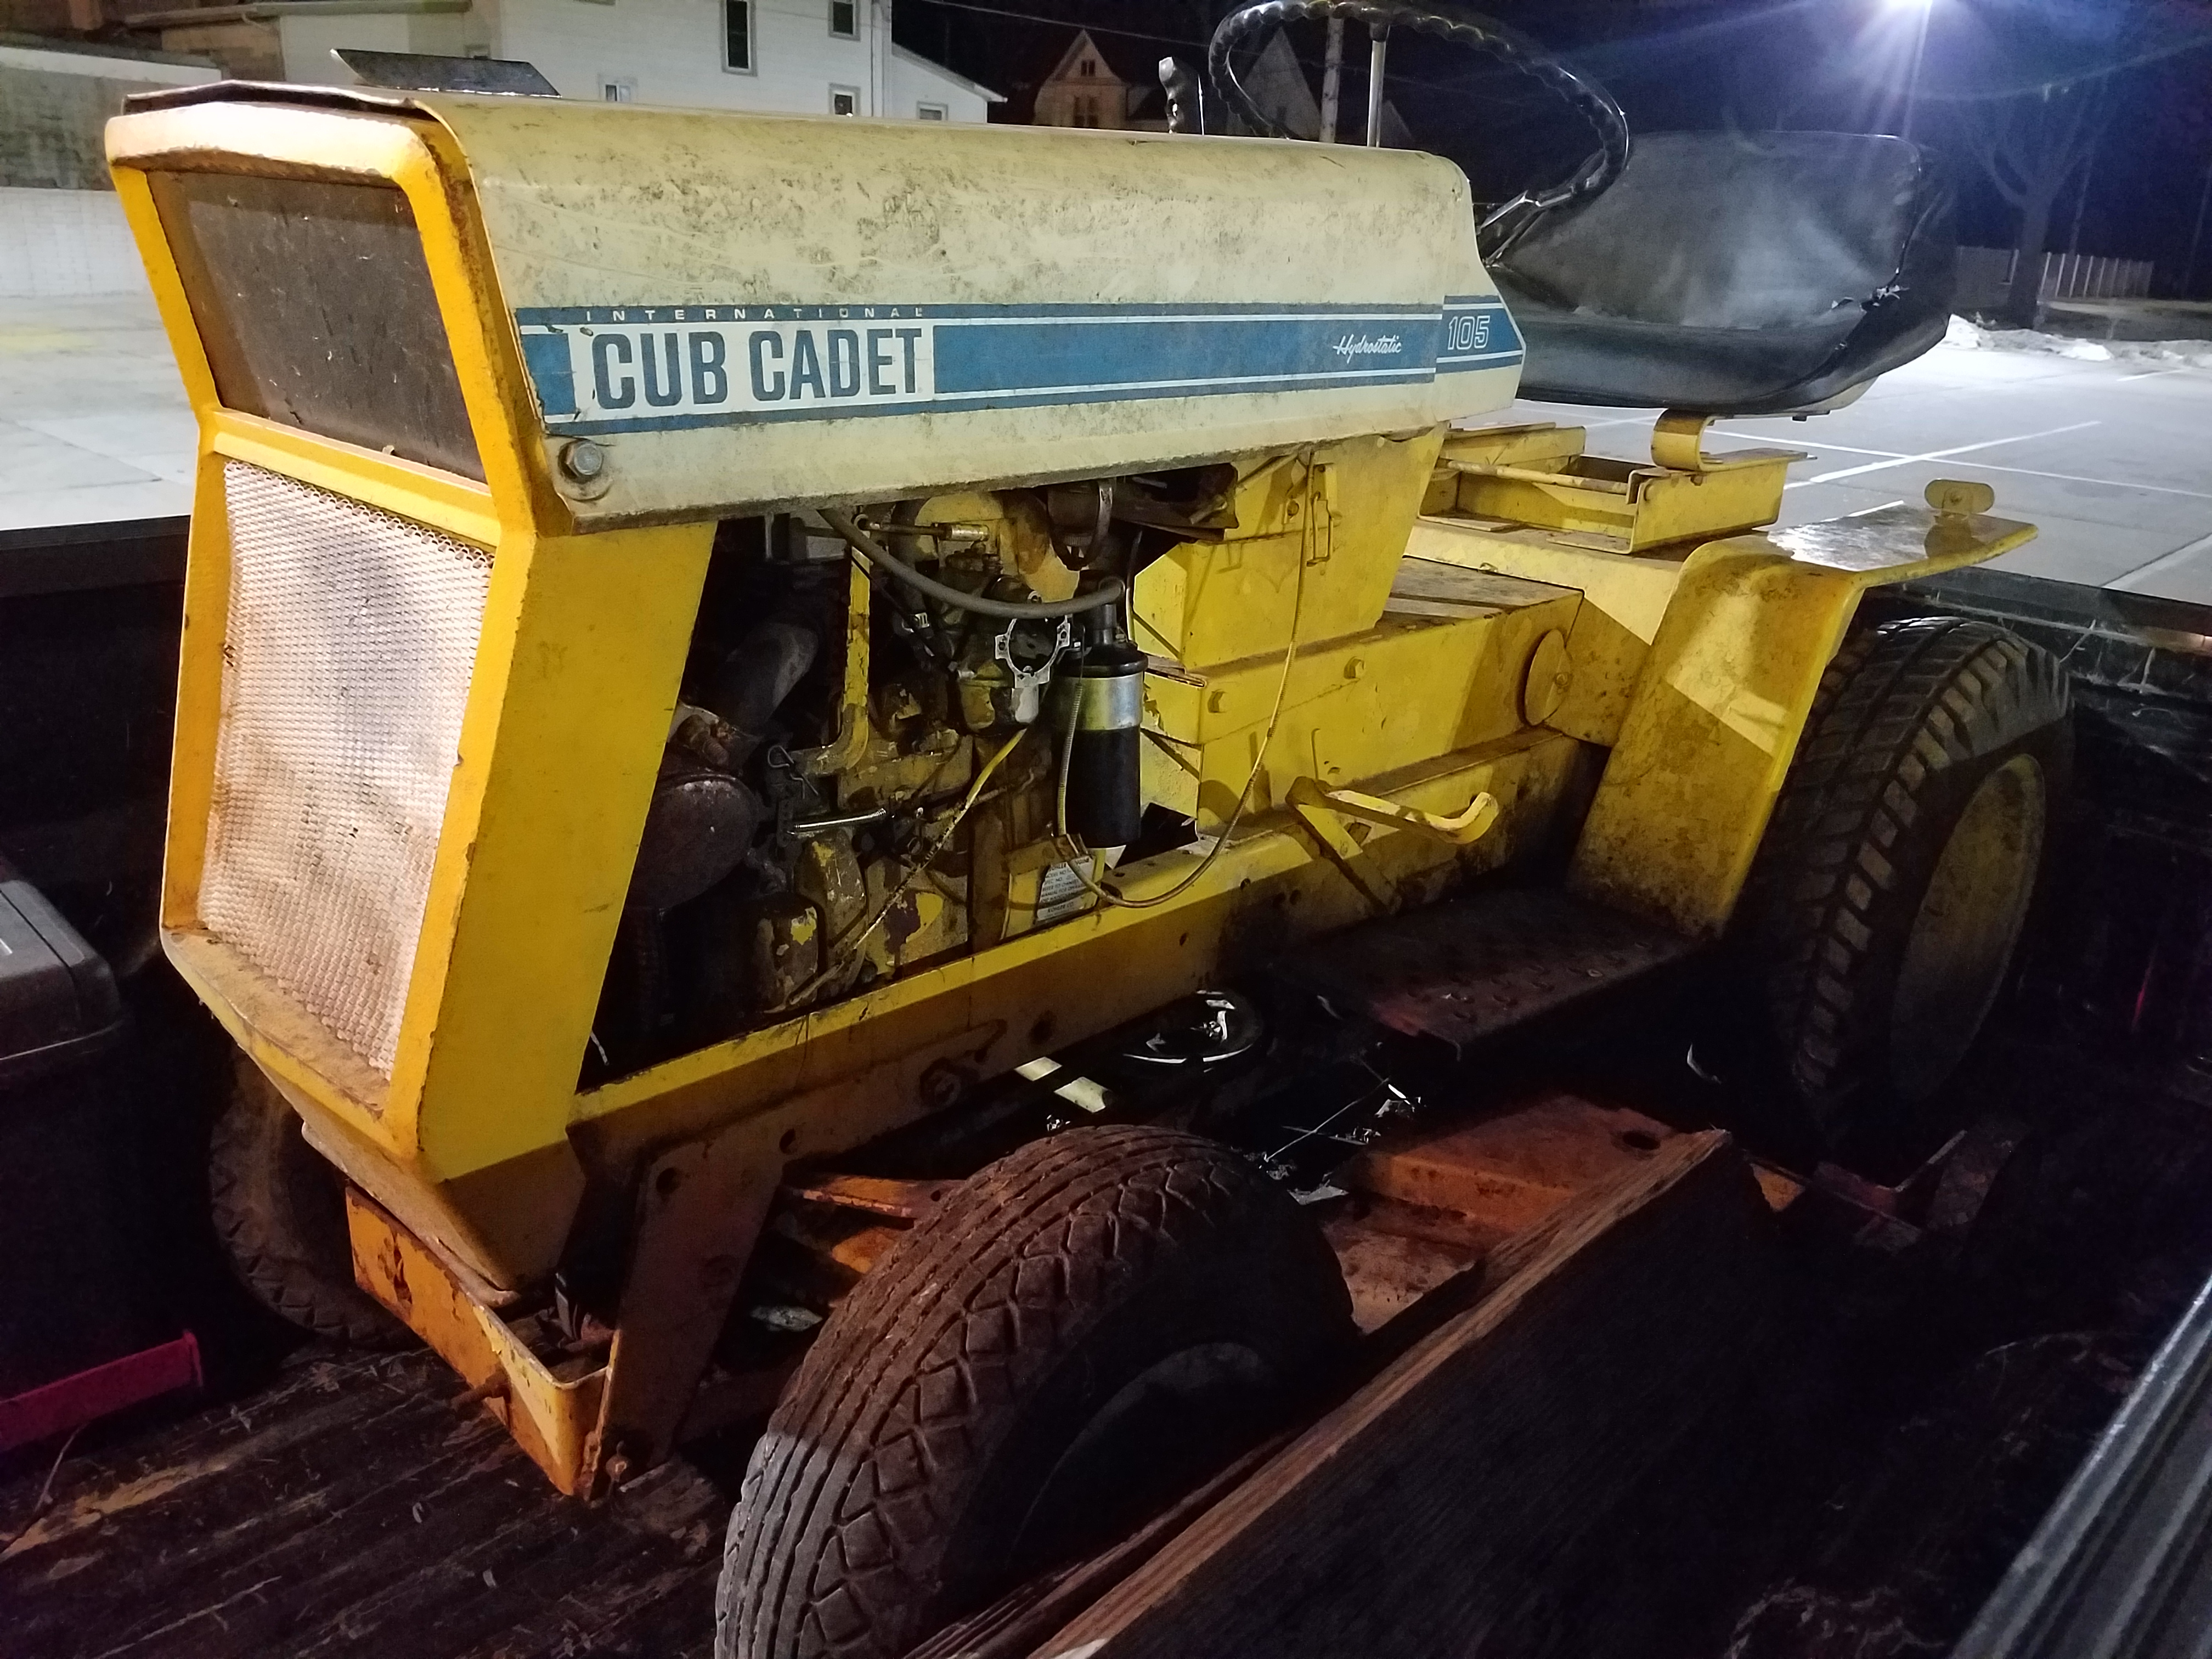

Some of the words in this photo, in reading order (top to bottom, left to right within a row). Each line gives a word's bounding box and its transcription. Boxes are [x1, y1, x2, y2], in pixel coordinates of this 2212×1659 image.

[586, 307, 923, 321] INTERNATIONAL
[1333, 334, 1402, 364] Hydrostatic
[1447, 315, 1491, 351] 105
[591, 331, 727, 409] CUB
[749, 328, 922, 402] CADET
